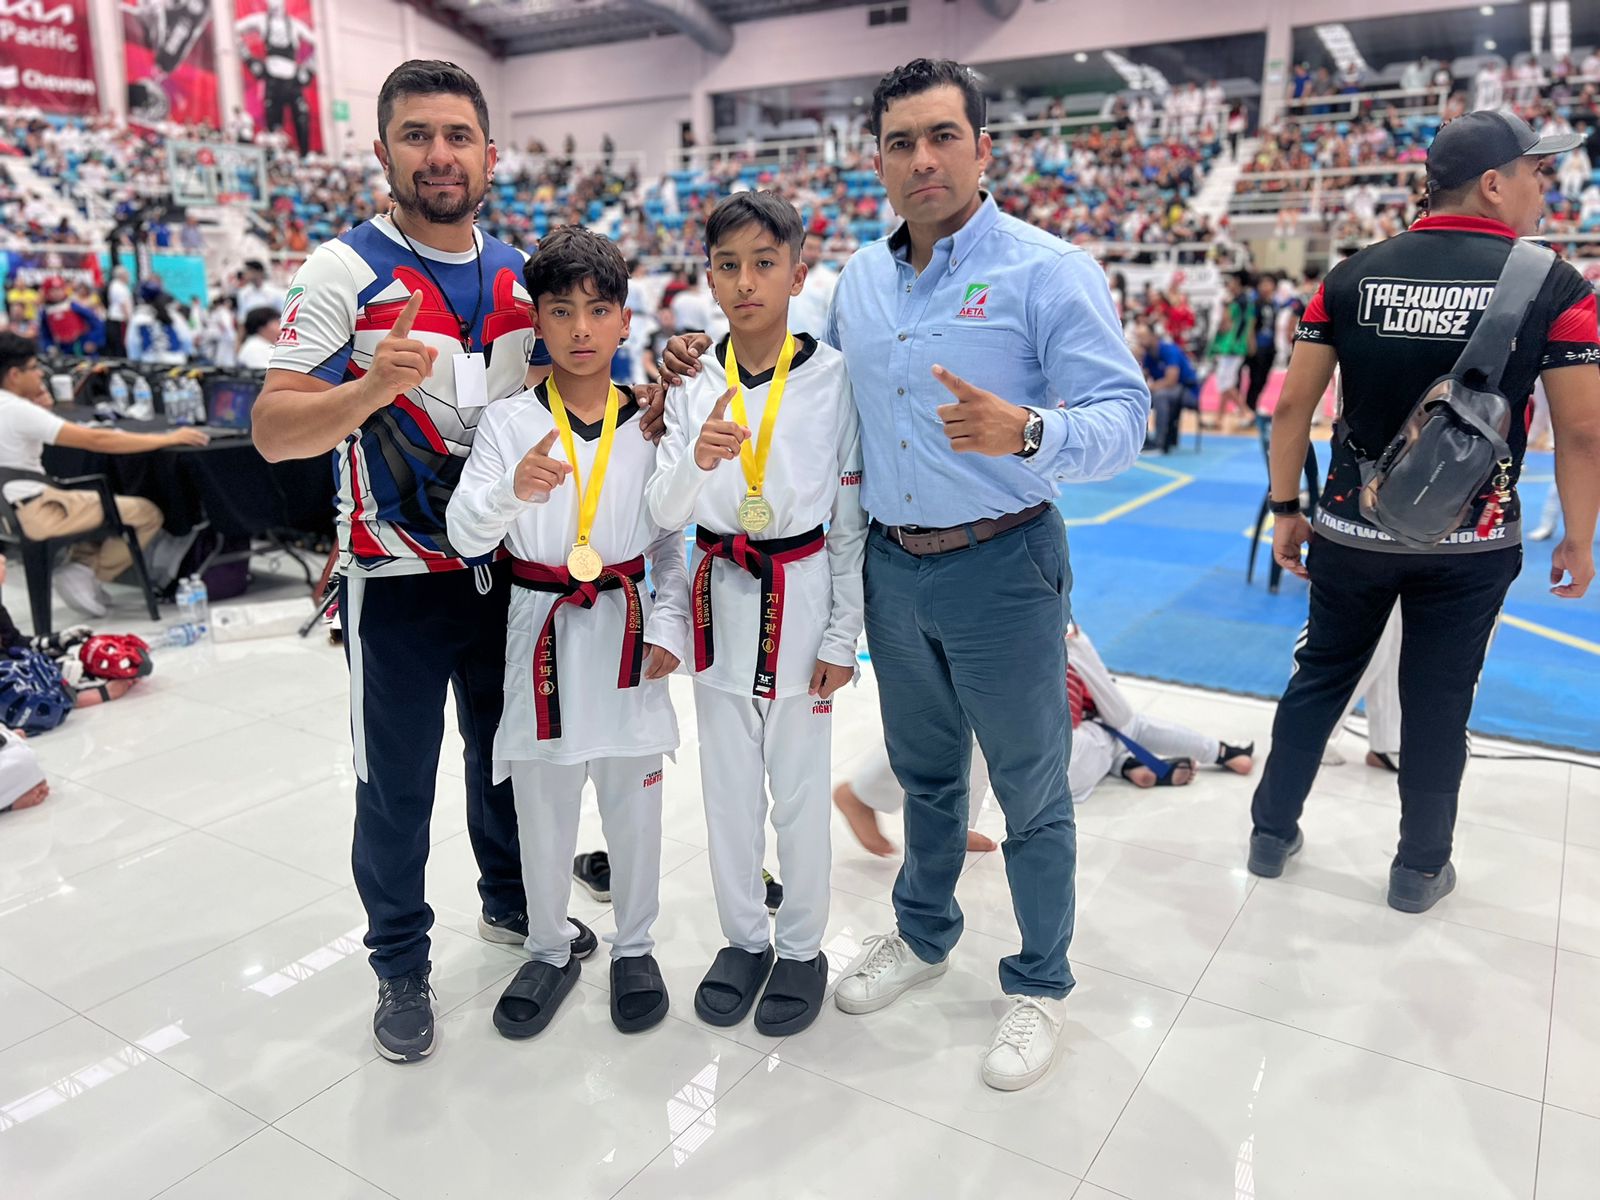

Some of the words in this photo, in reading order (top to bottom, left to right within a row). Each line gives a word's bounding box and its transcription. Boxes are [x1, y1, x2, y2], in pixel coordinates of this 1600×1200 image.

[21, 68, 97, 97] Chevron
[959, 307, 985, 316] AETA
[1364, 283, 1496, 320] TAEKWOND
[1383, 307, 1471, 335] LIONSZ
[702, 595, 710, 623] FLORES
